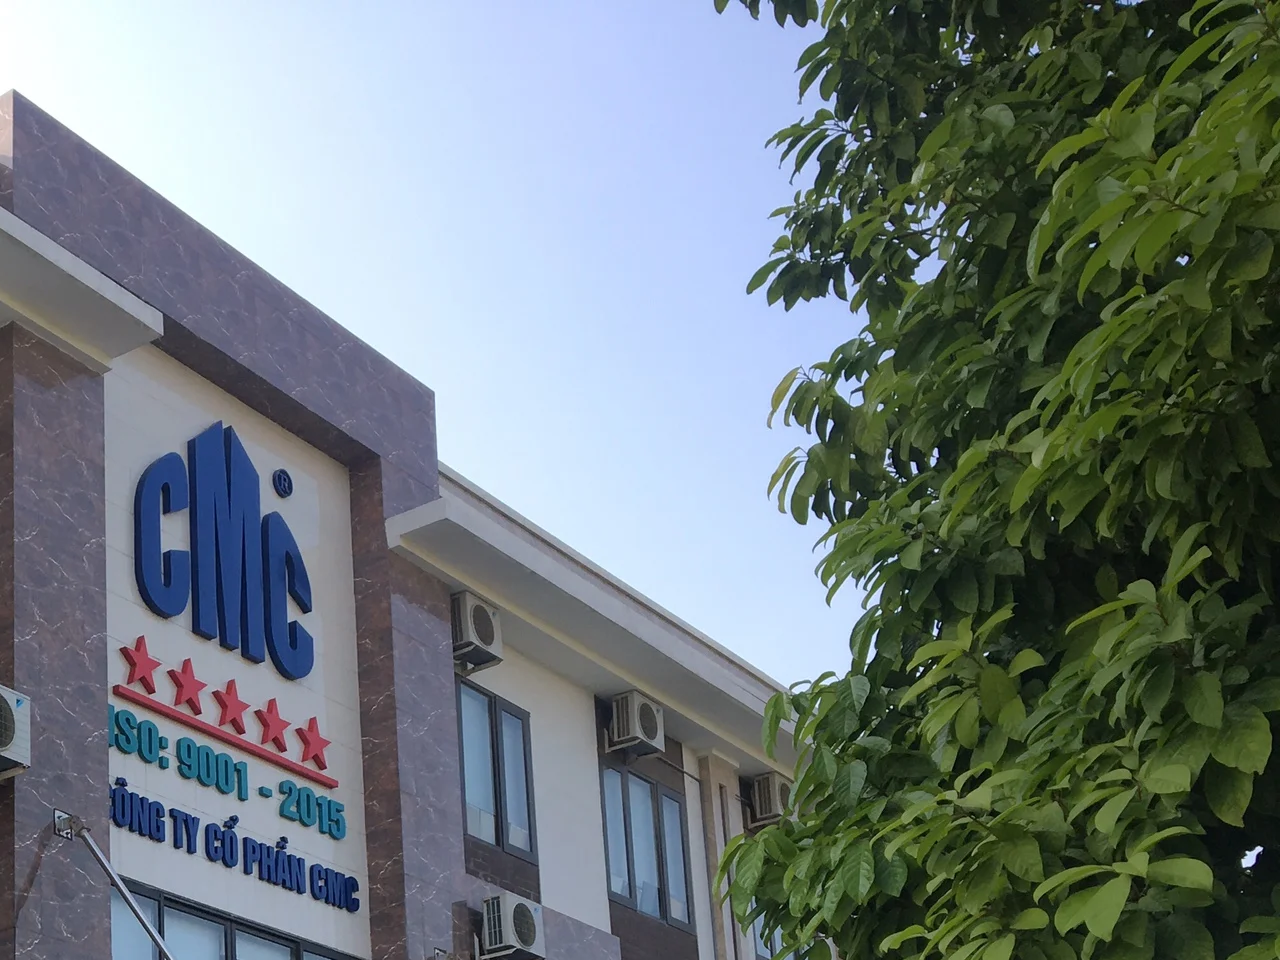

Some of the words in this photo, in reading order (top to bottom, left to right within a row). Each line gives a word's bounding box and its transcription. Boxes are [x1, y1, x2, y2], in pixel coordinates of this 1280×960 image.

[134, 420, 314, 681] CMC
[108, 703, 170, 770] ISO:
[176, 737, 249, 802] 9001
[258, 786, 273, 798] -
[279, 780, 347, 841] 2015
[109, 777, 166, 843] ÔNG
[169, 808, 200, 855] TY
[205, 815, 239, 869] CỔ
[242, 836, 306, 895] PHẦN
[310, 863, 360, 913] CMC
